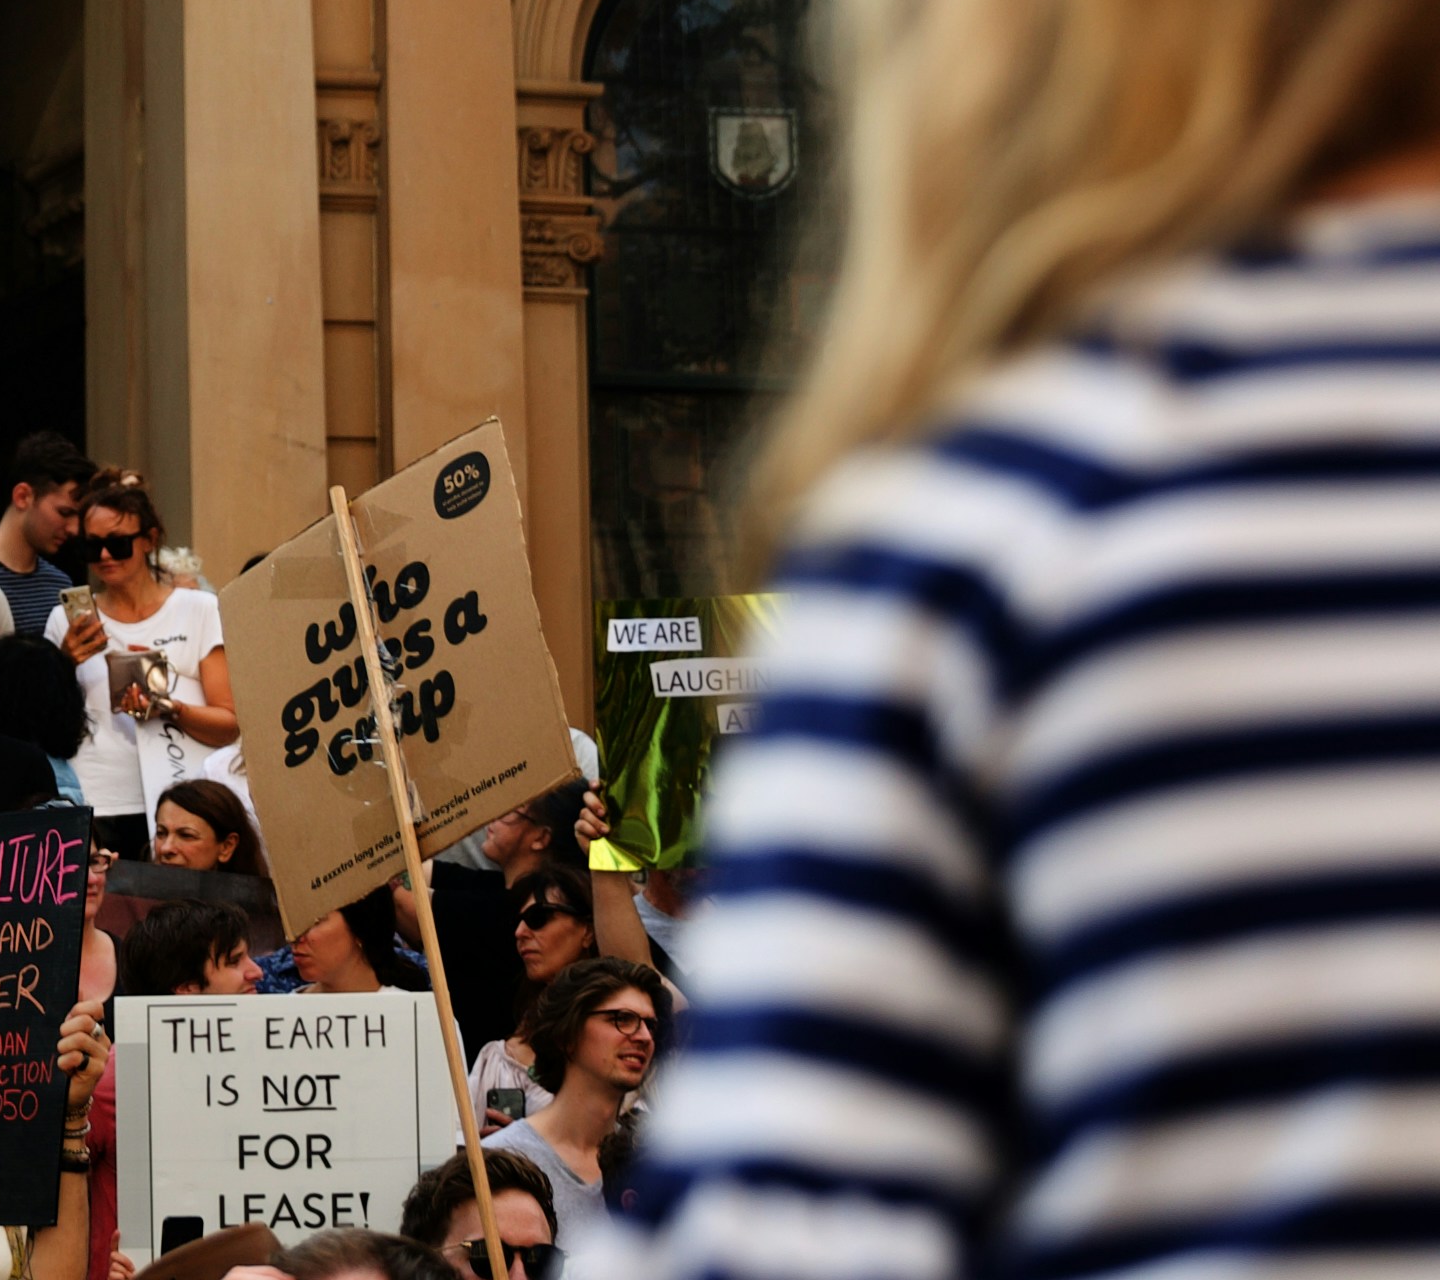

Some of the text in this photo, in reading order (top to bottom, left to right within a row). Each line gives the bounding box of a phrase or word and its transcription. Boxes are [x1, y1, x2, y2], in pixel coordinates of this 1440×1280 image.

[443, 464, 479, 494] 50%
[444, 590, 487, 645] a
[614, 621, 697, 645] WE ARE
[354, 847, 374, 863] long
[375, 835, 394, 851] rolls
[430, 790, 470, 820] recycled
[471, 776, 497, 796] toilet
[498, 760, 528, 783] paper
[162, 1014, 386, 1053] THE EARTH
[206, 1074, 340, 1107] IS NOT
[238, 1133, 332, 1169] FOR
[218, 1192, 370, 1229] LEASE!
